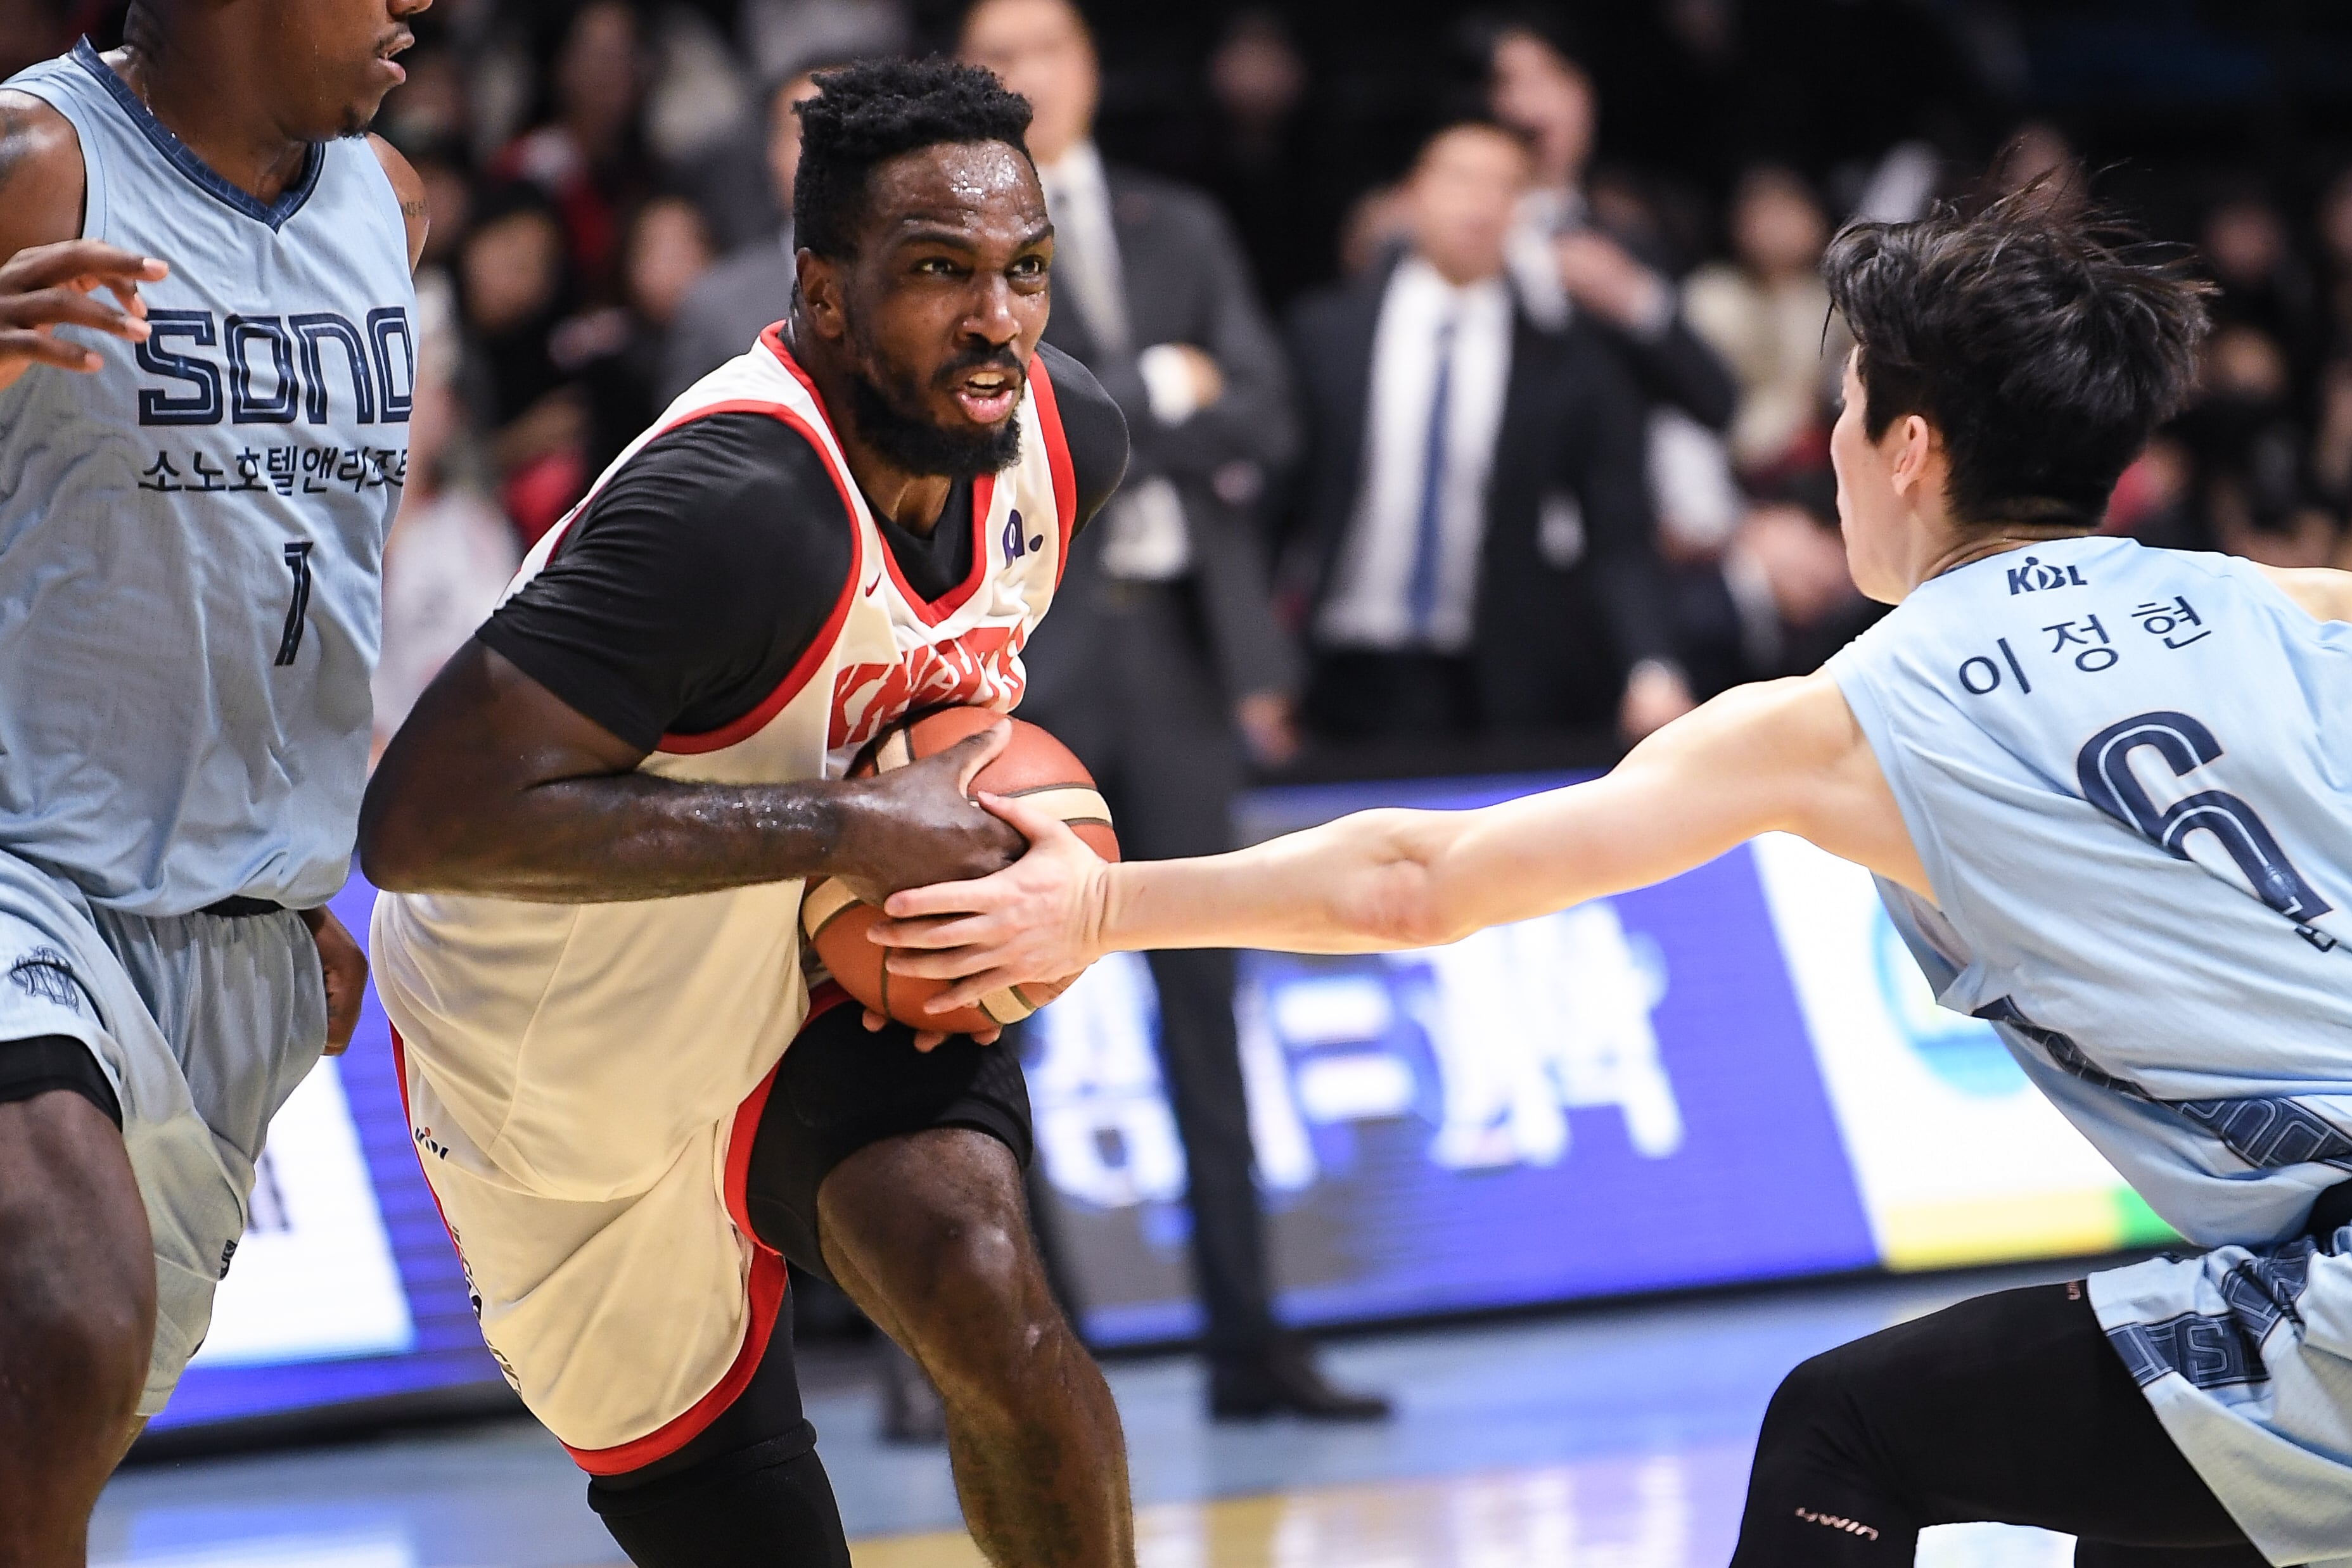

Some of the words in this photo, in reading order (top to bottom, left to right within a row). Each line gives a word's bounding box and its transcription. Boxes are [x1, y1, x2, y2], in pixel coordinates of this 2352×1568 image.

[274, 542, 313, 666] 1
[2007, 556, 2088, 596] KBL
[2076, 711, 2334, 923] 6
